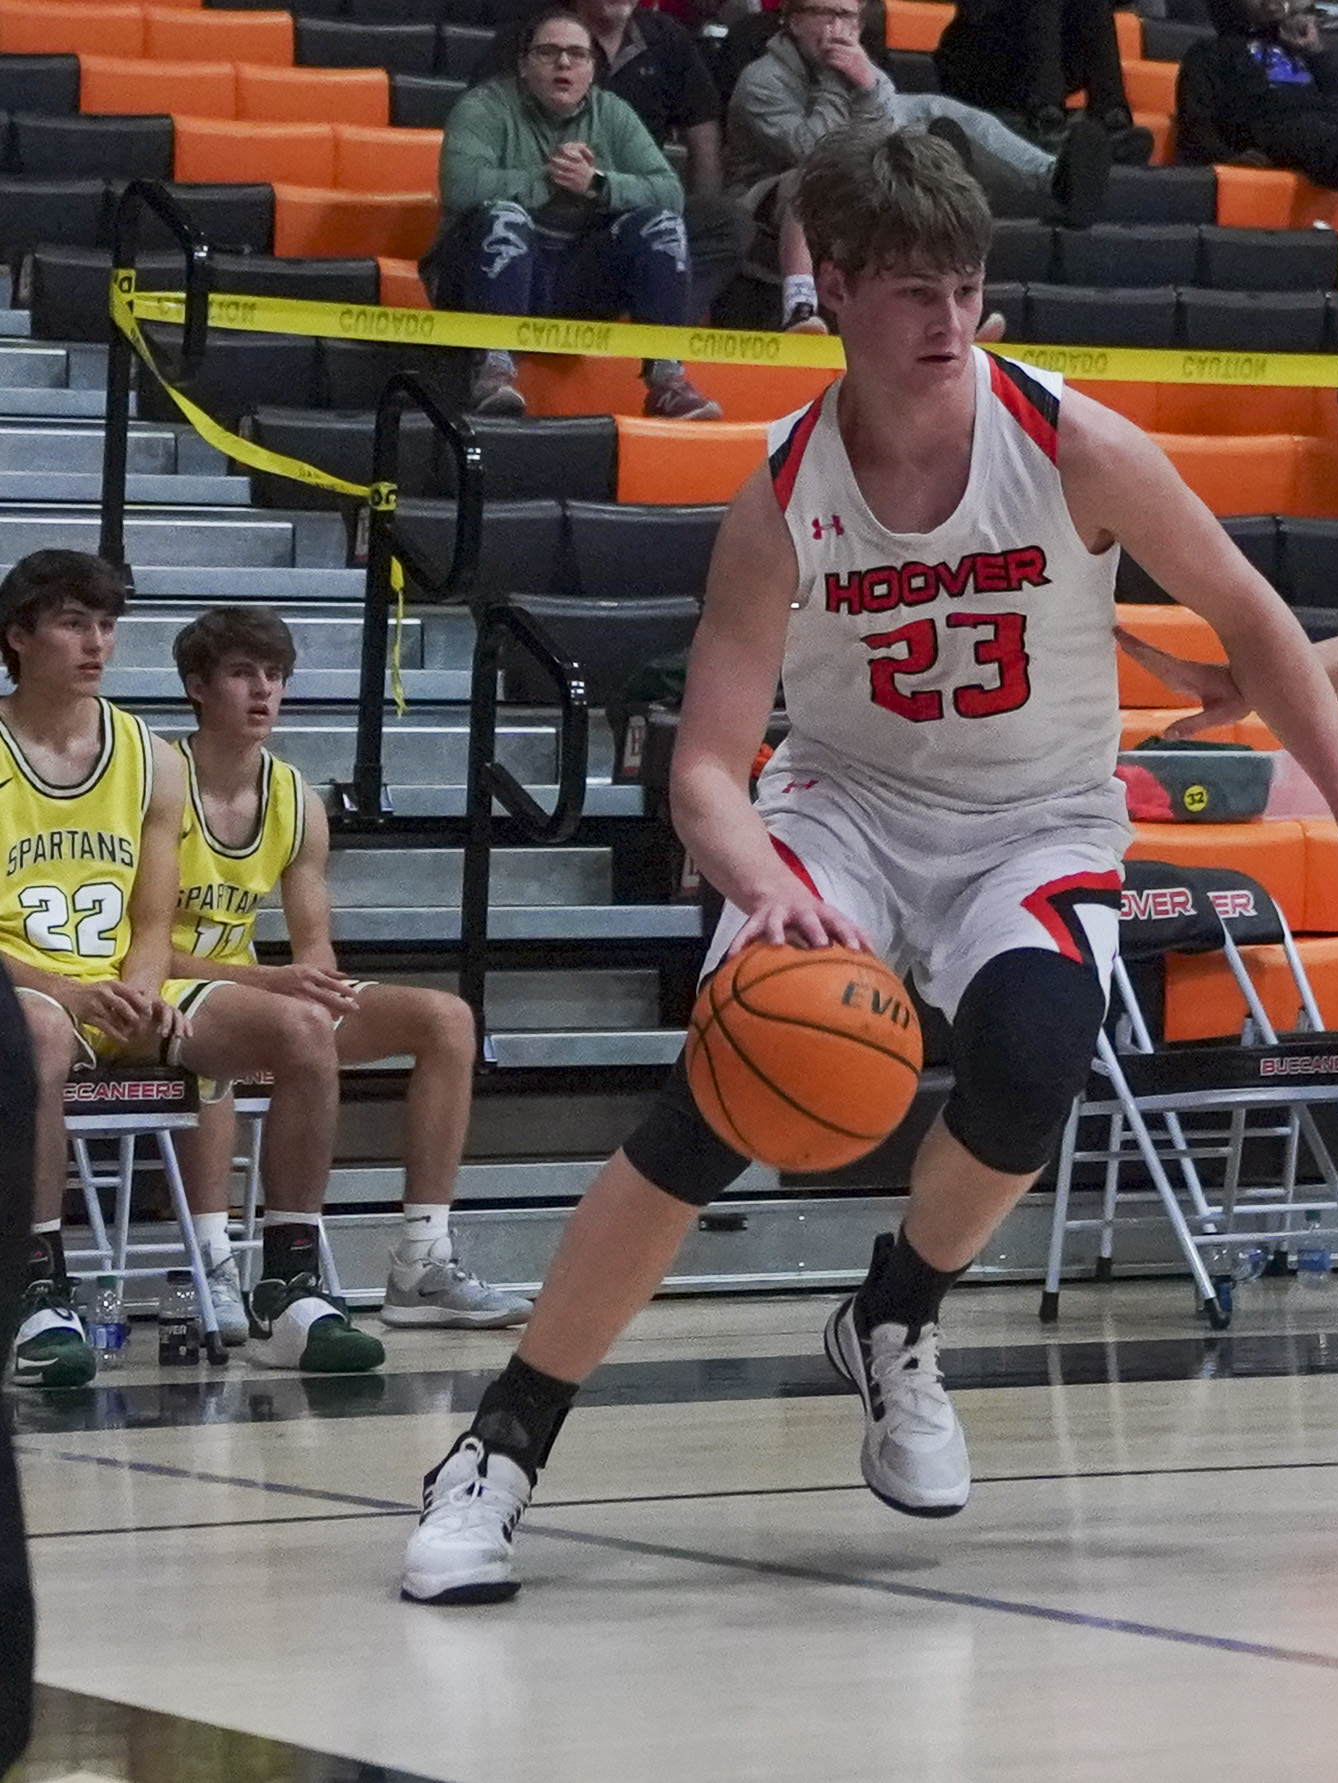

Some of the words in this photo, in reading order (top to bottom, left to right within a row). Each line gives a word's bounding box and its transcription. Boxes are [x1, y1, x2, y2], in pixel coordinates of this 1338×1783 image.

[825, 545, 1052, 615] HOOVER
[860, 612, 1031, 723] 23
[7, 831, 134, 876] SPARTANS
[17, 882, 124, 957] 22
